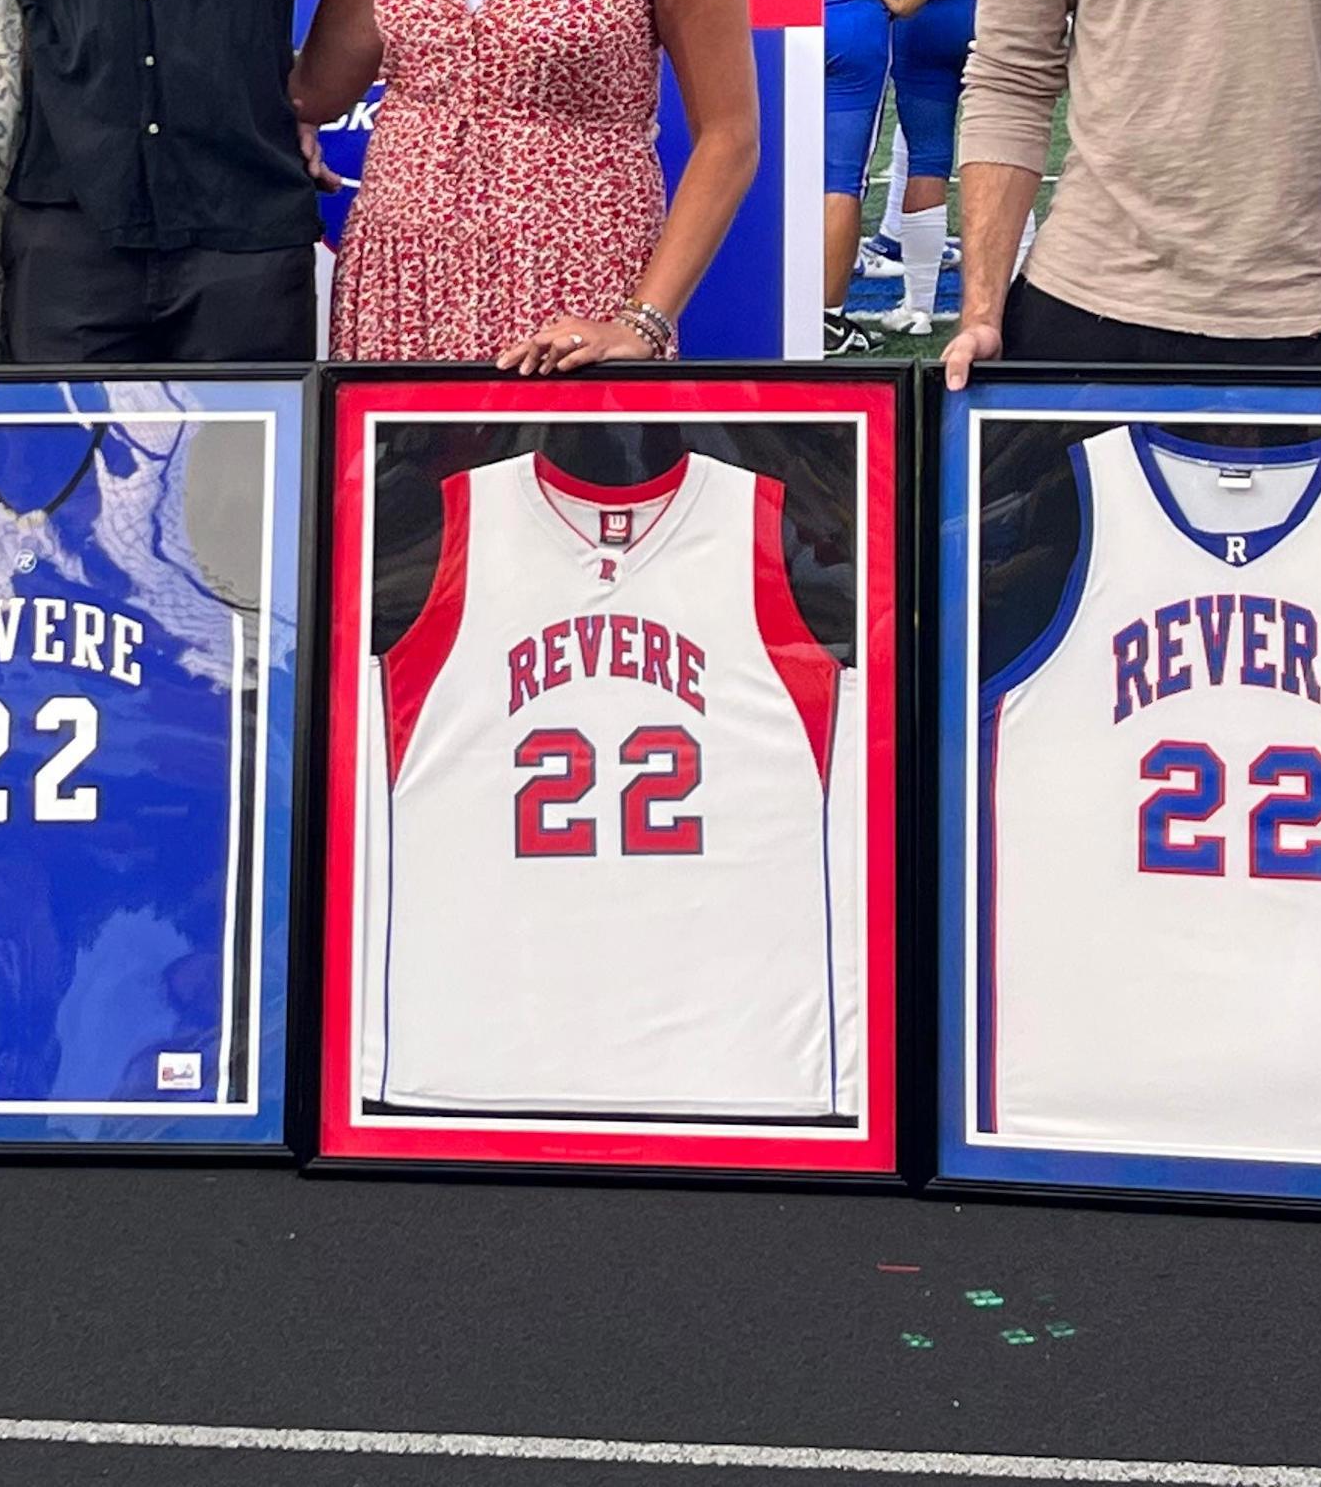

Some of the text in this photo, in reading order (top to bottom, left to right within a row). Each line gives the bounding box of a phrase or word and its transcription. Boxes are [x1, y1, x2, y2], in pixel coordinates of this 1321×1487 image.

[599, 558, 618, 583] R
[1226, 535, 1248, 564] R
[508, 613, 707, 718] REVERE
[514, 724, 704, 859] 22
